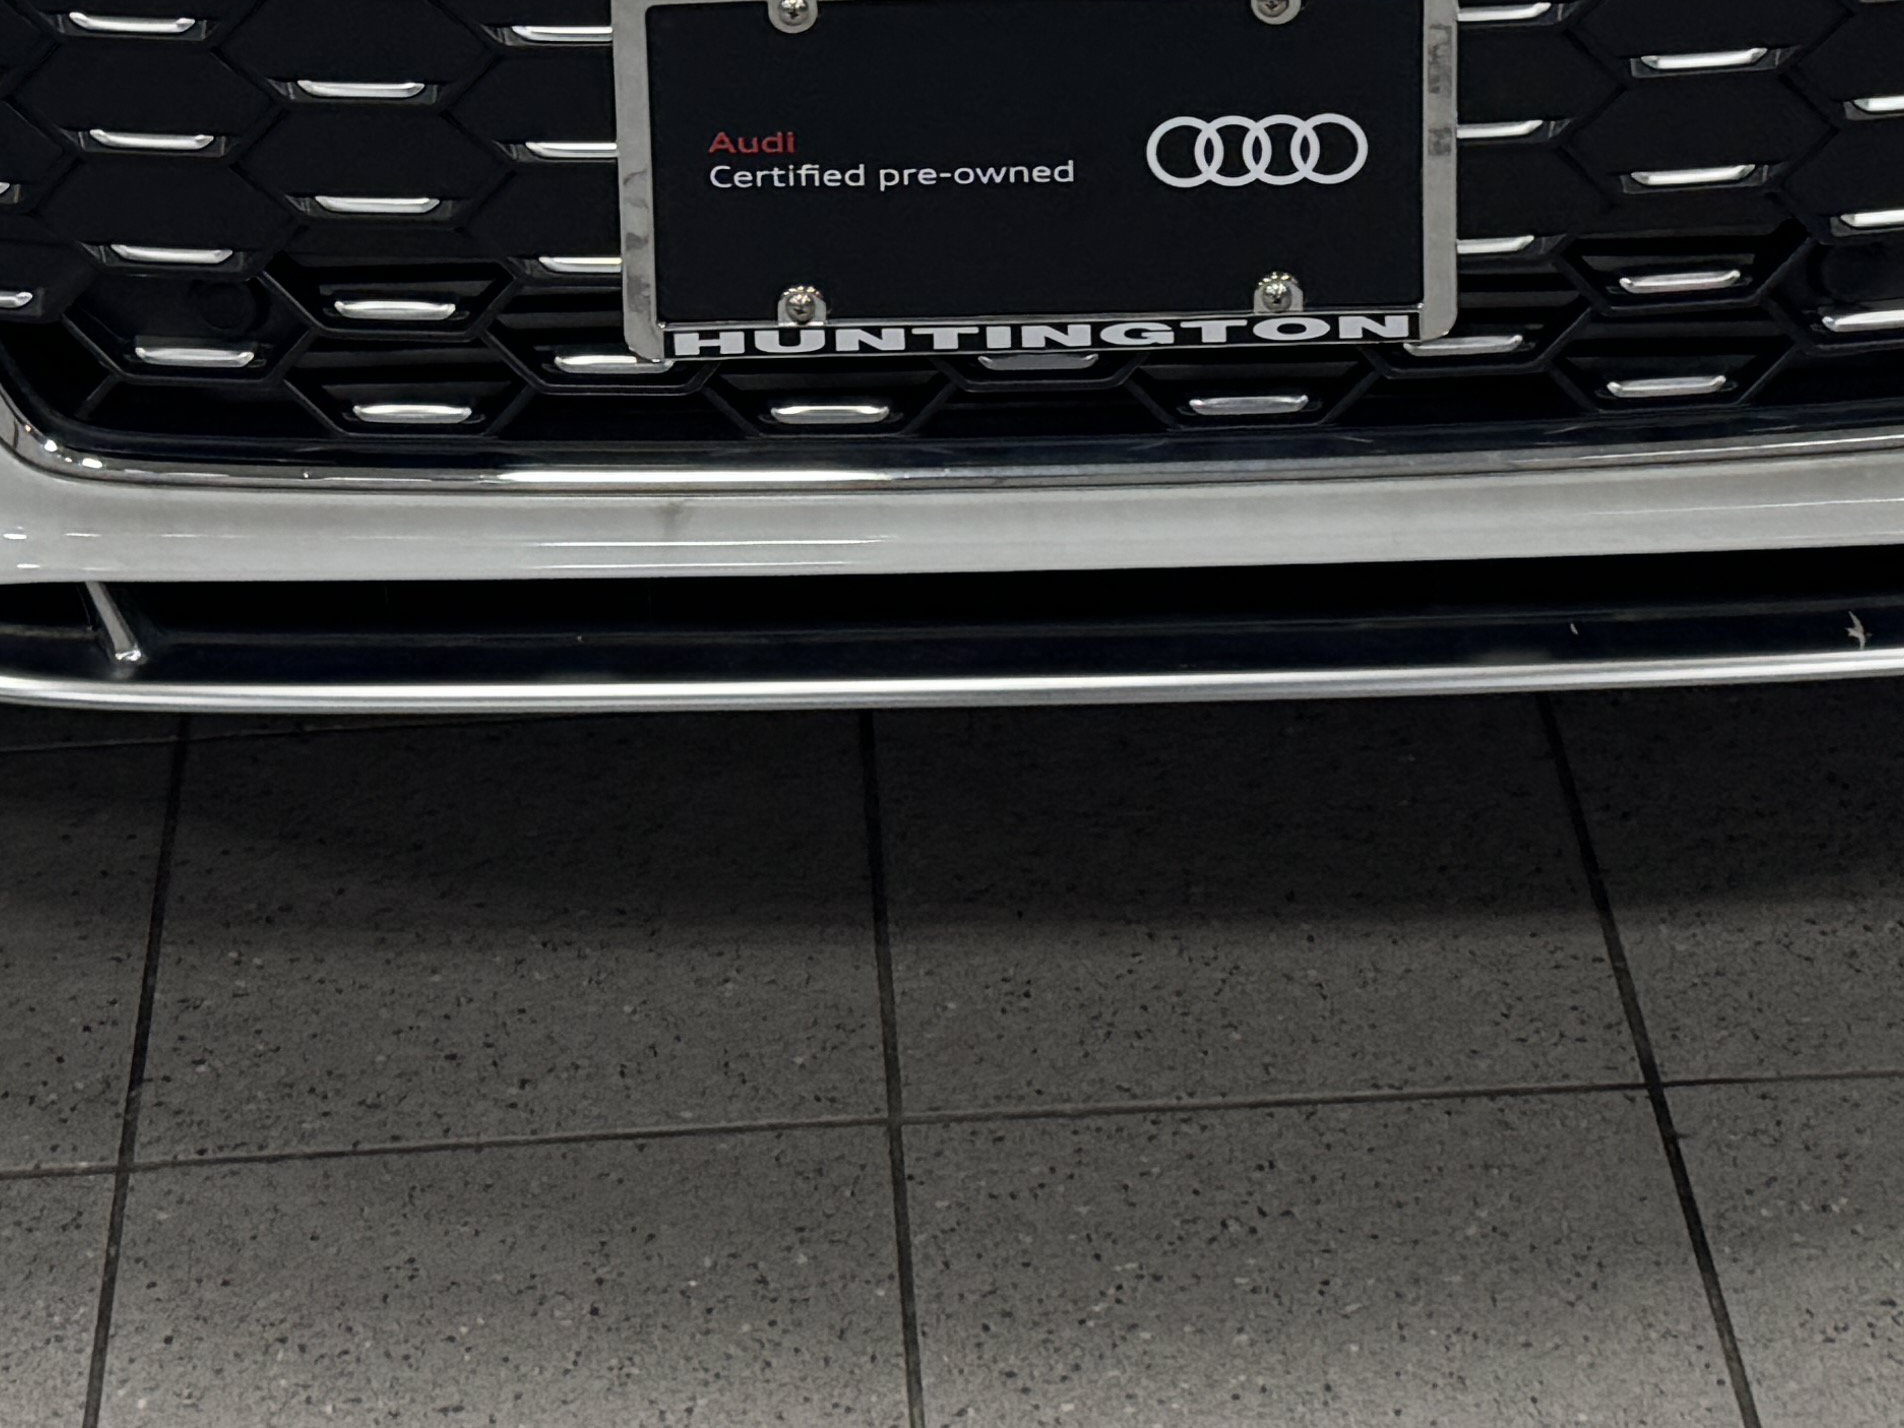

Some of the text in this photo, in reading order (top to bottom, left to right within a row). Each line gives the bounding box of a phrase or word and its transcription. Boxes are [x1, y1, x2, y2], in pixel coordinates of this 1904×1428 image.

[708, 131, 795, 154] Audi
[709, 160, 1075, 191] Certified pre-owned
[674, 315, 1409, 356] HUNTINGTON
